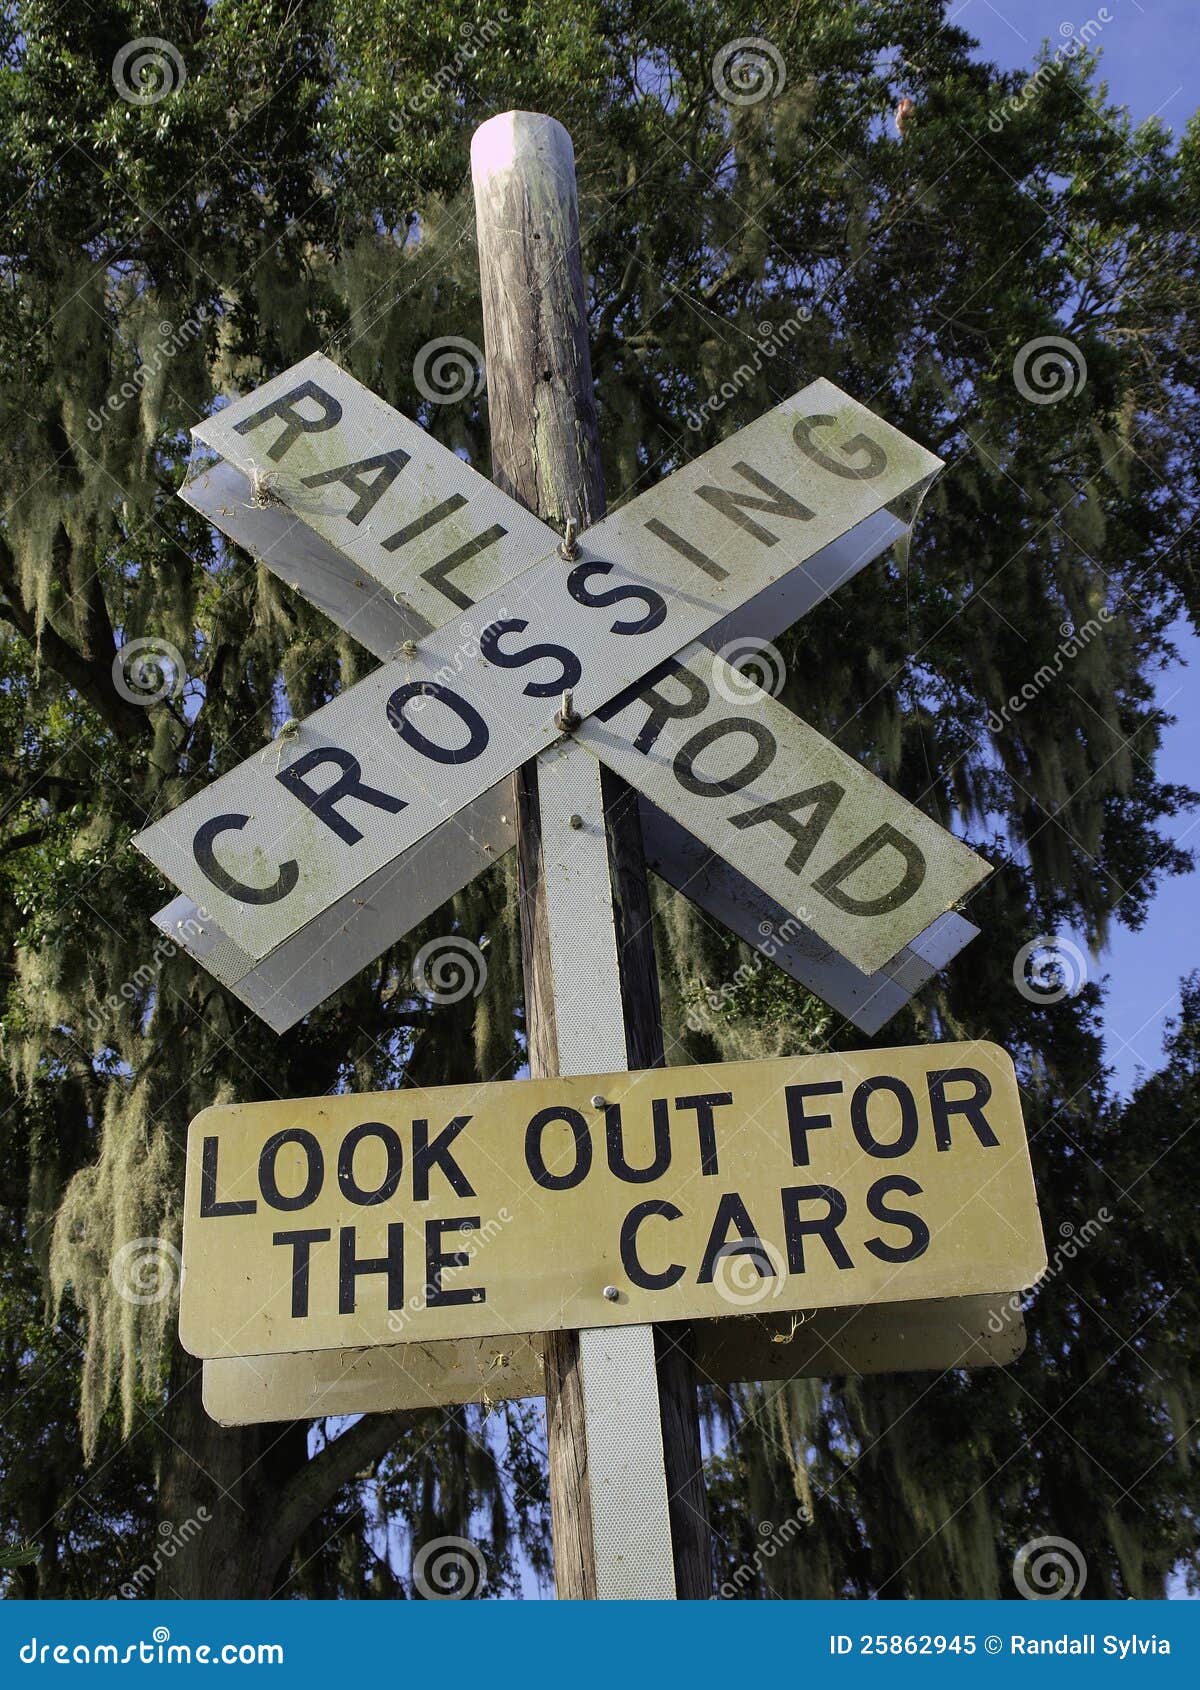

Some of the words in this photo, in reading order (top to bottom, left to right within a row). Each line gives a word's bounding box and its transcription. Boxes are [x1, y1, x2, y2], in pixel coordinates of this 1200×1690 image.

[193, 414, 887, 905] CROSSING
[233, 380, 508, 611] RAIL
[596, 656, 927, 917] ROAD
[200, 1115, 476, 1218] LOOK
[525, 1092, 733, 1190] OUT
[785, 1067, 1000, 1166] FOR
[273, 1216, 486, 1318] THE
[619, 1175, 930, 1290] CARS
